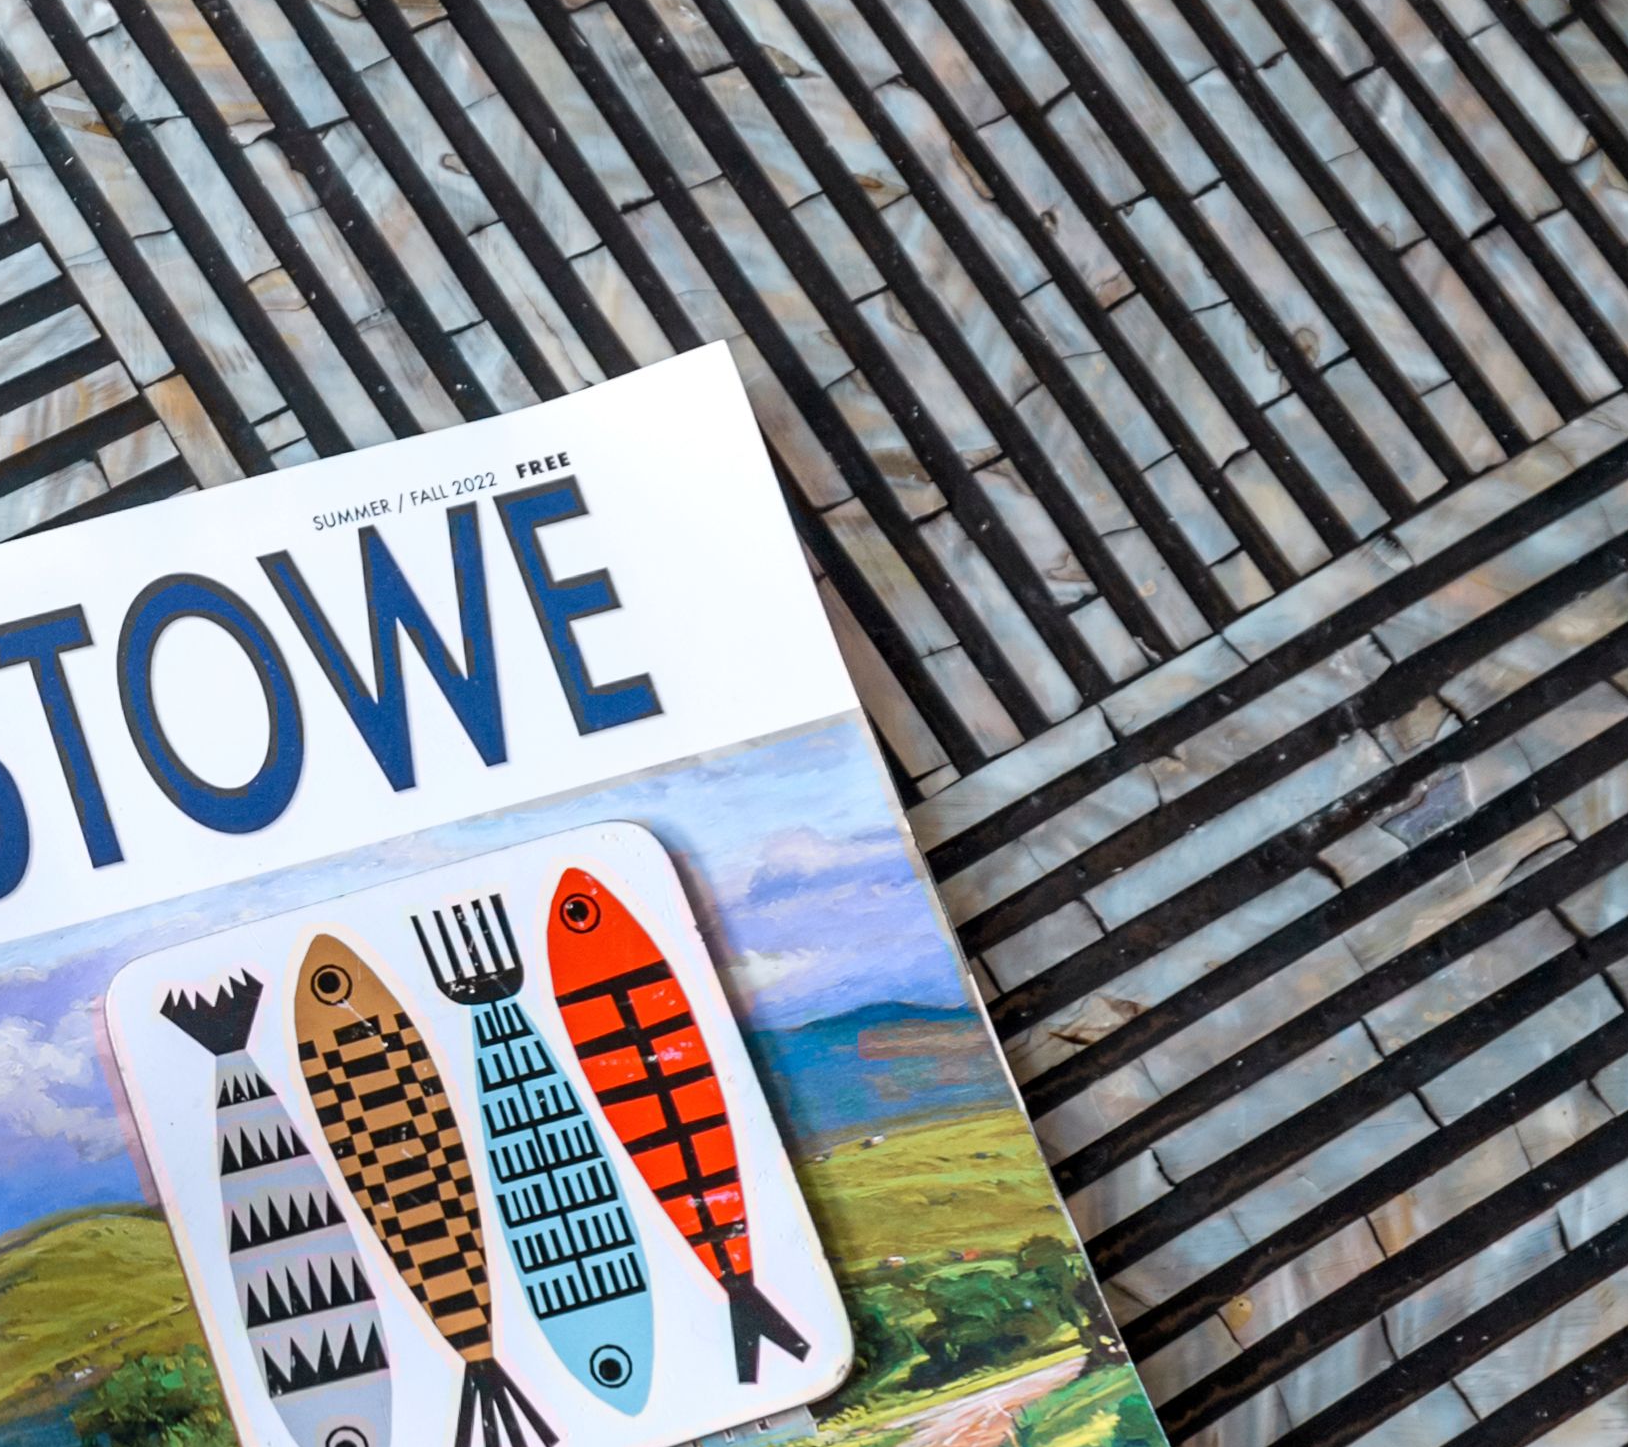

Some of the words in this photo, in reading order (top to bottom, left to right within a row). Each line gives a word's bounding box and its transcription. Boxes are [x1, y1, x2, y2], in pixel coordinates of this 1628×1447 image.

[312, 497, 392, 531] SUMMER
[409, 485, 449, 507] FALL
[451, 471, 498, 497] 2022
[515, 451, 572, 479] FREE
